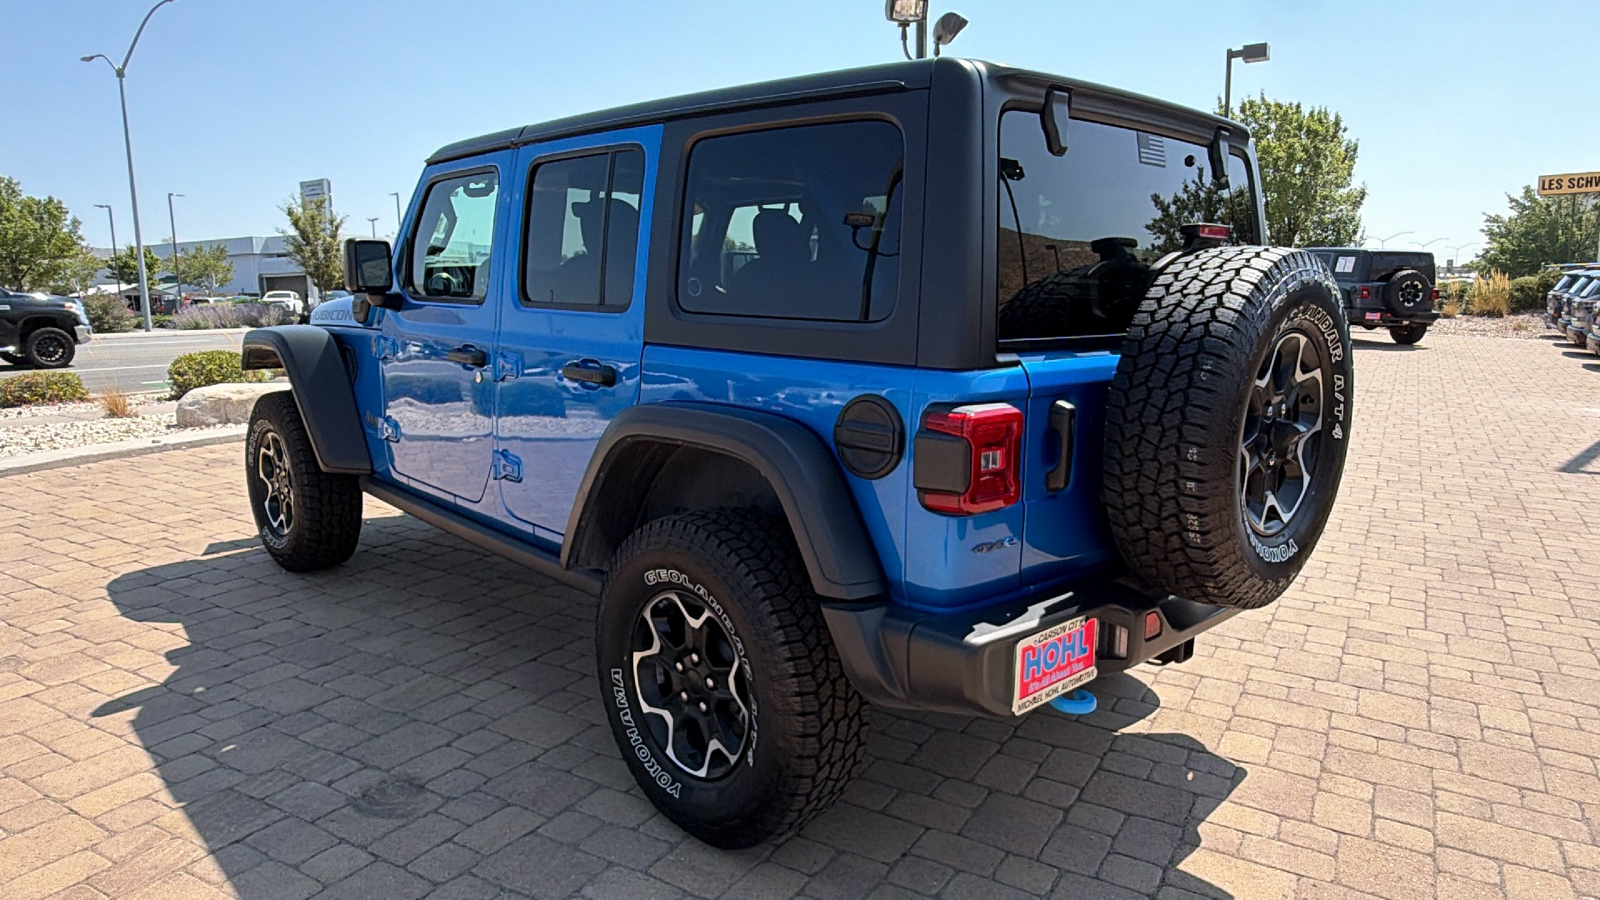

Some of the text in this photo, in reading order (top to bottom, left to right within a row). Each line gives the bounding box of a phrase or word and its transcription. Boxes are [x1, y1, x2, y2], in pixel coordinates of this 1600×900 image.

[1541, 178, 1563, 191] LES
[312, 309, 353, 321] RUBICON
[1038, 624, 1068, 643] CARSON
[1024, 628, 1088, 681] HOHL
[1044, 685, 1060, 699] HOHL
[611, 668, 681, 799] YOKOHAMA
